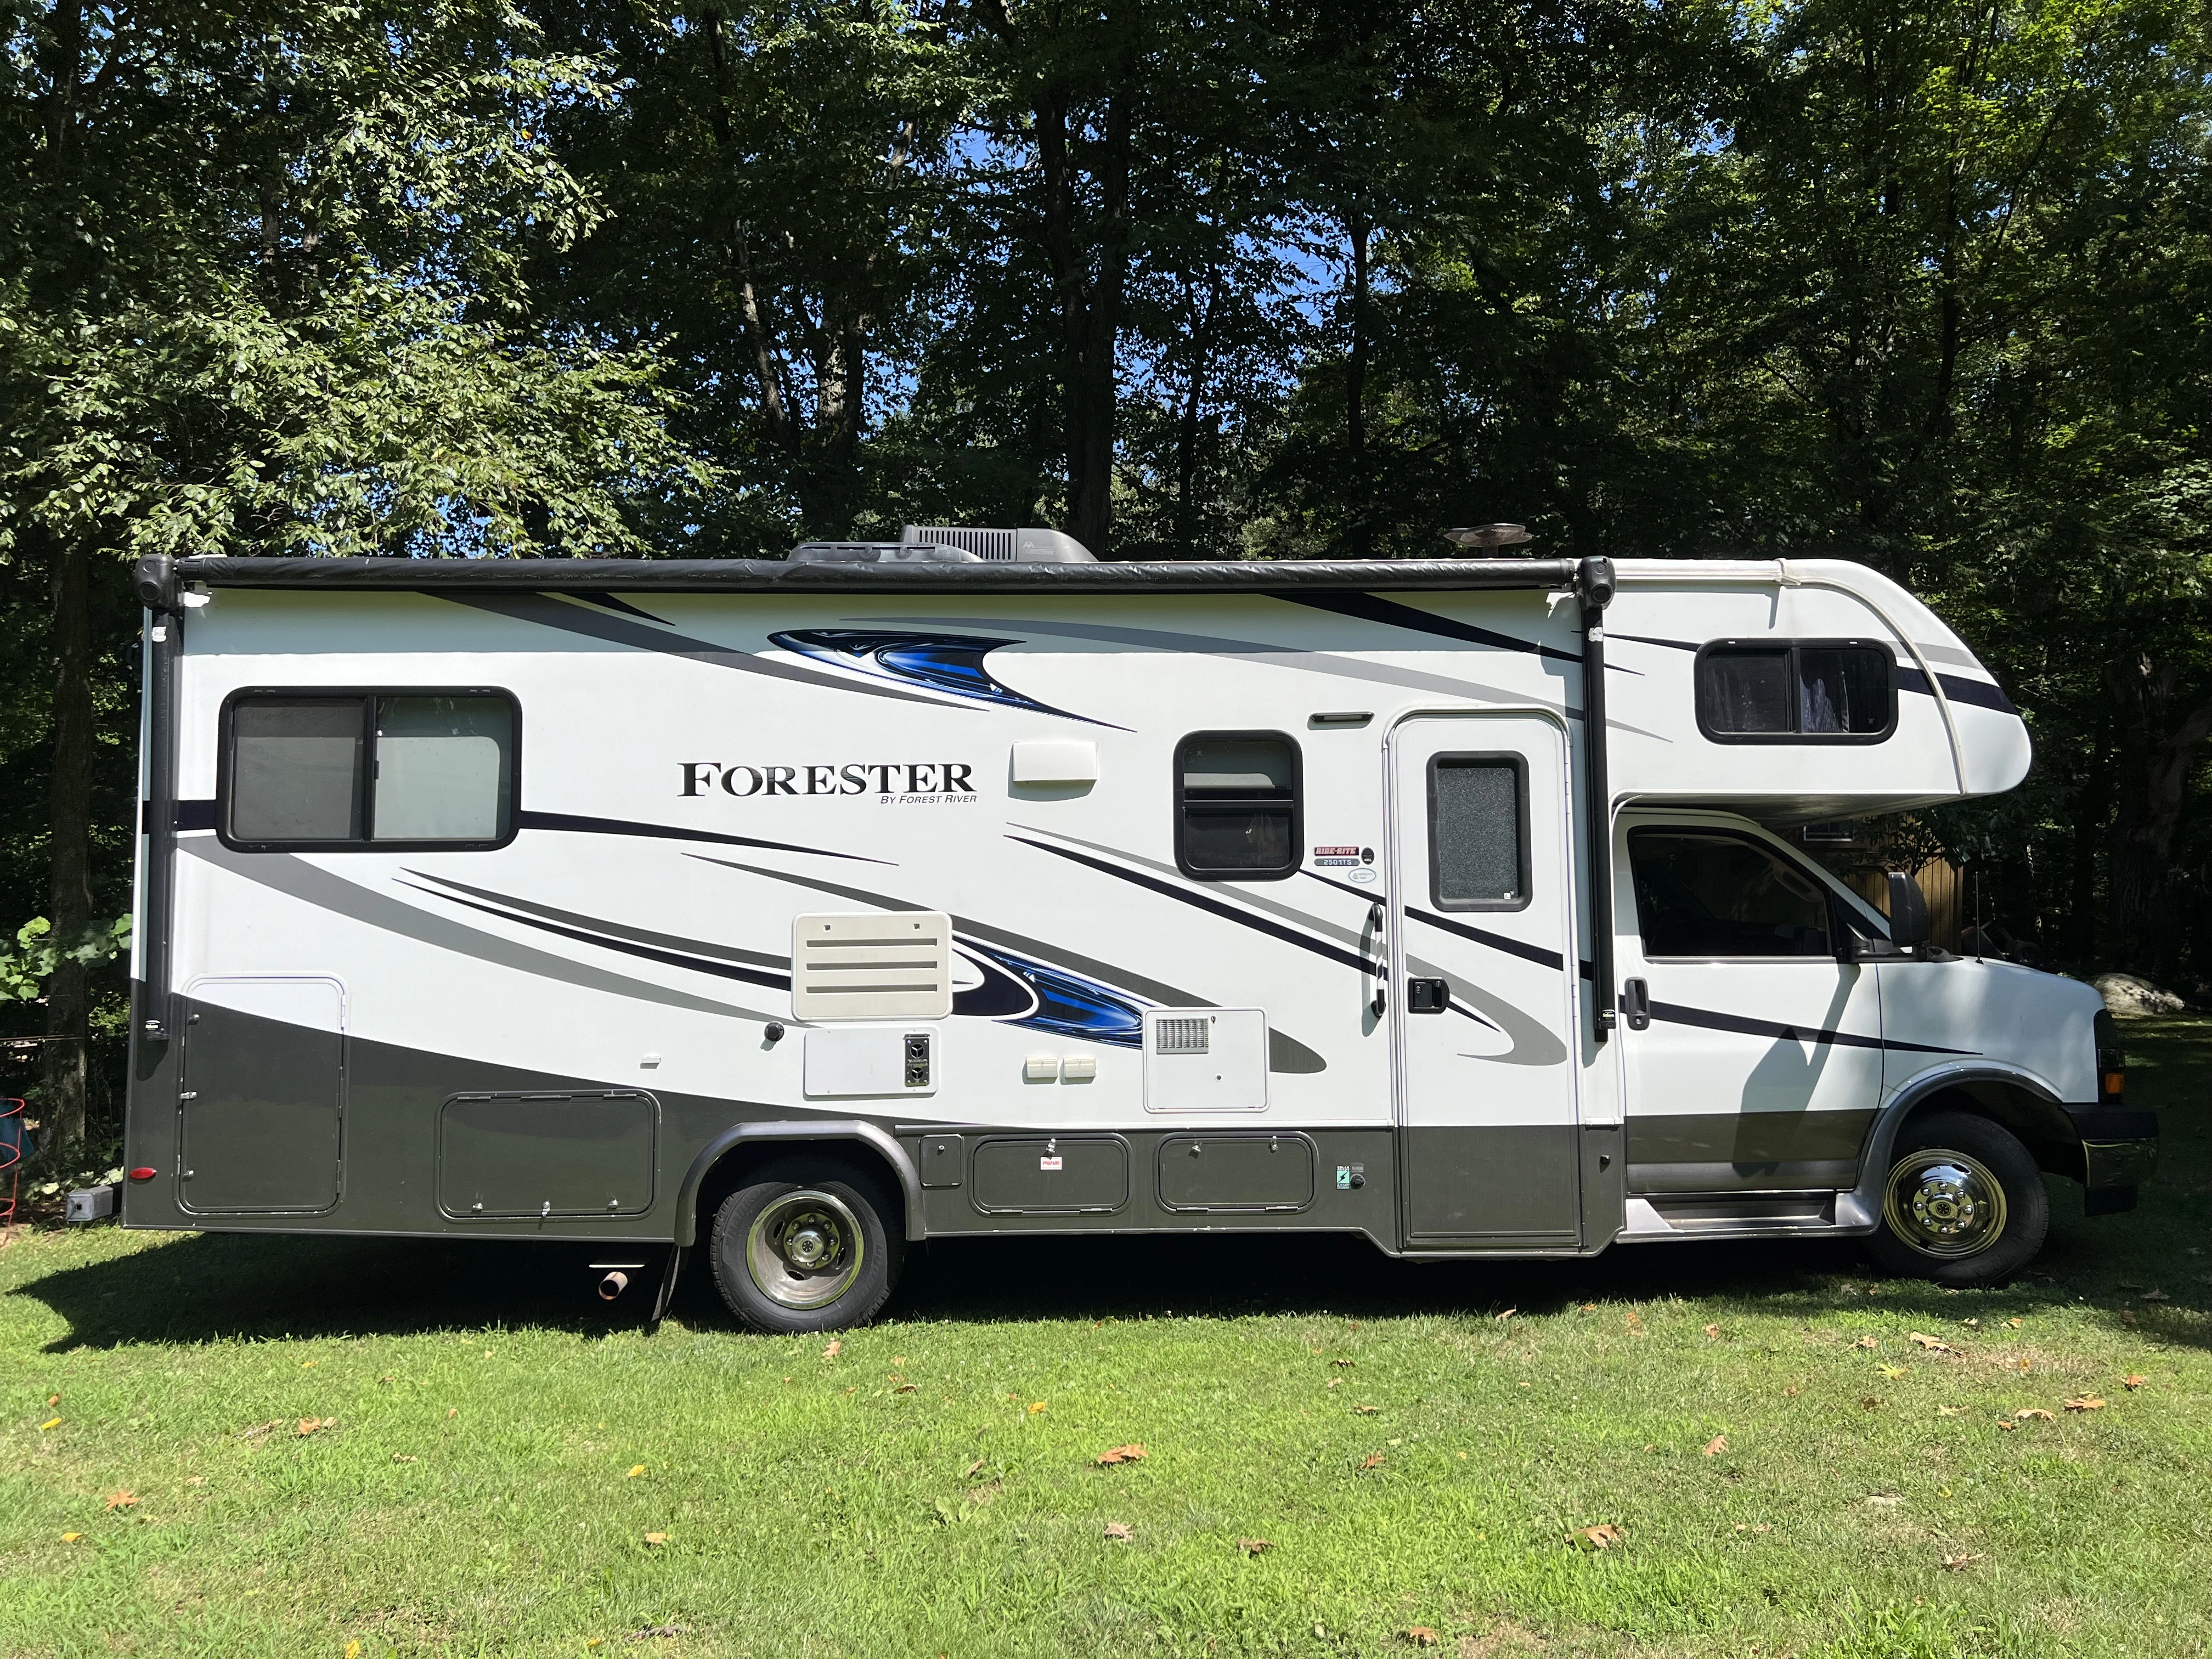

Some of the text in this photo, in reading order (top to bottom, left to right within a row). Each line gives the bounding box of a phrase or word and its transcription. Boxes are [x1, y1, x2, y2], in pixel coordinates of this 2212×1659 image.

[677, 763, 977, 797] FORESTER
[899, 795, 943, 804] FOREST
[945, 795, 977, 803] RIVER
